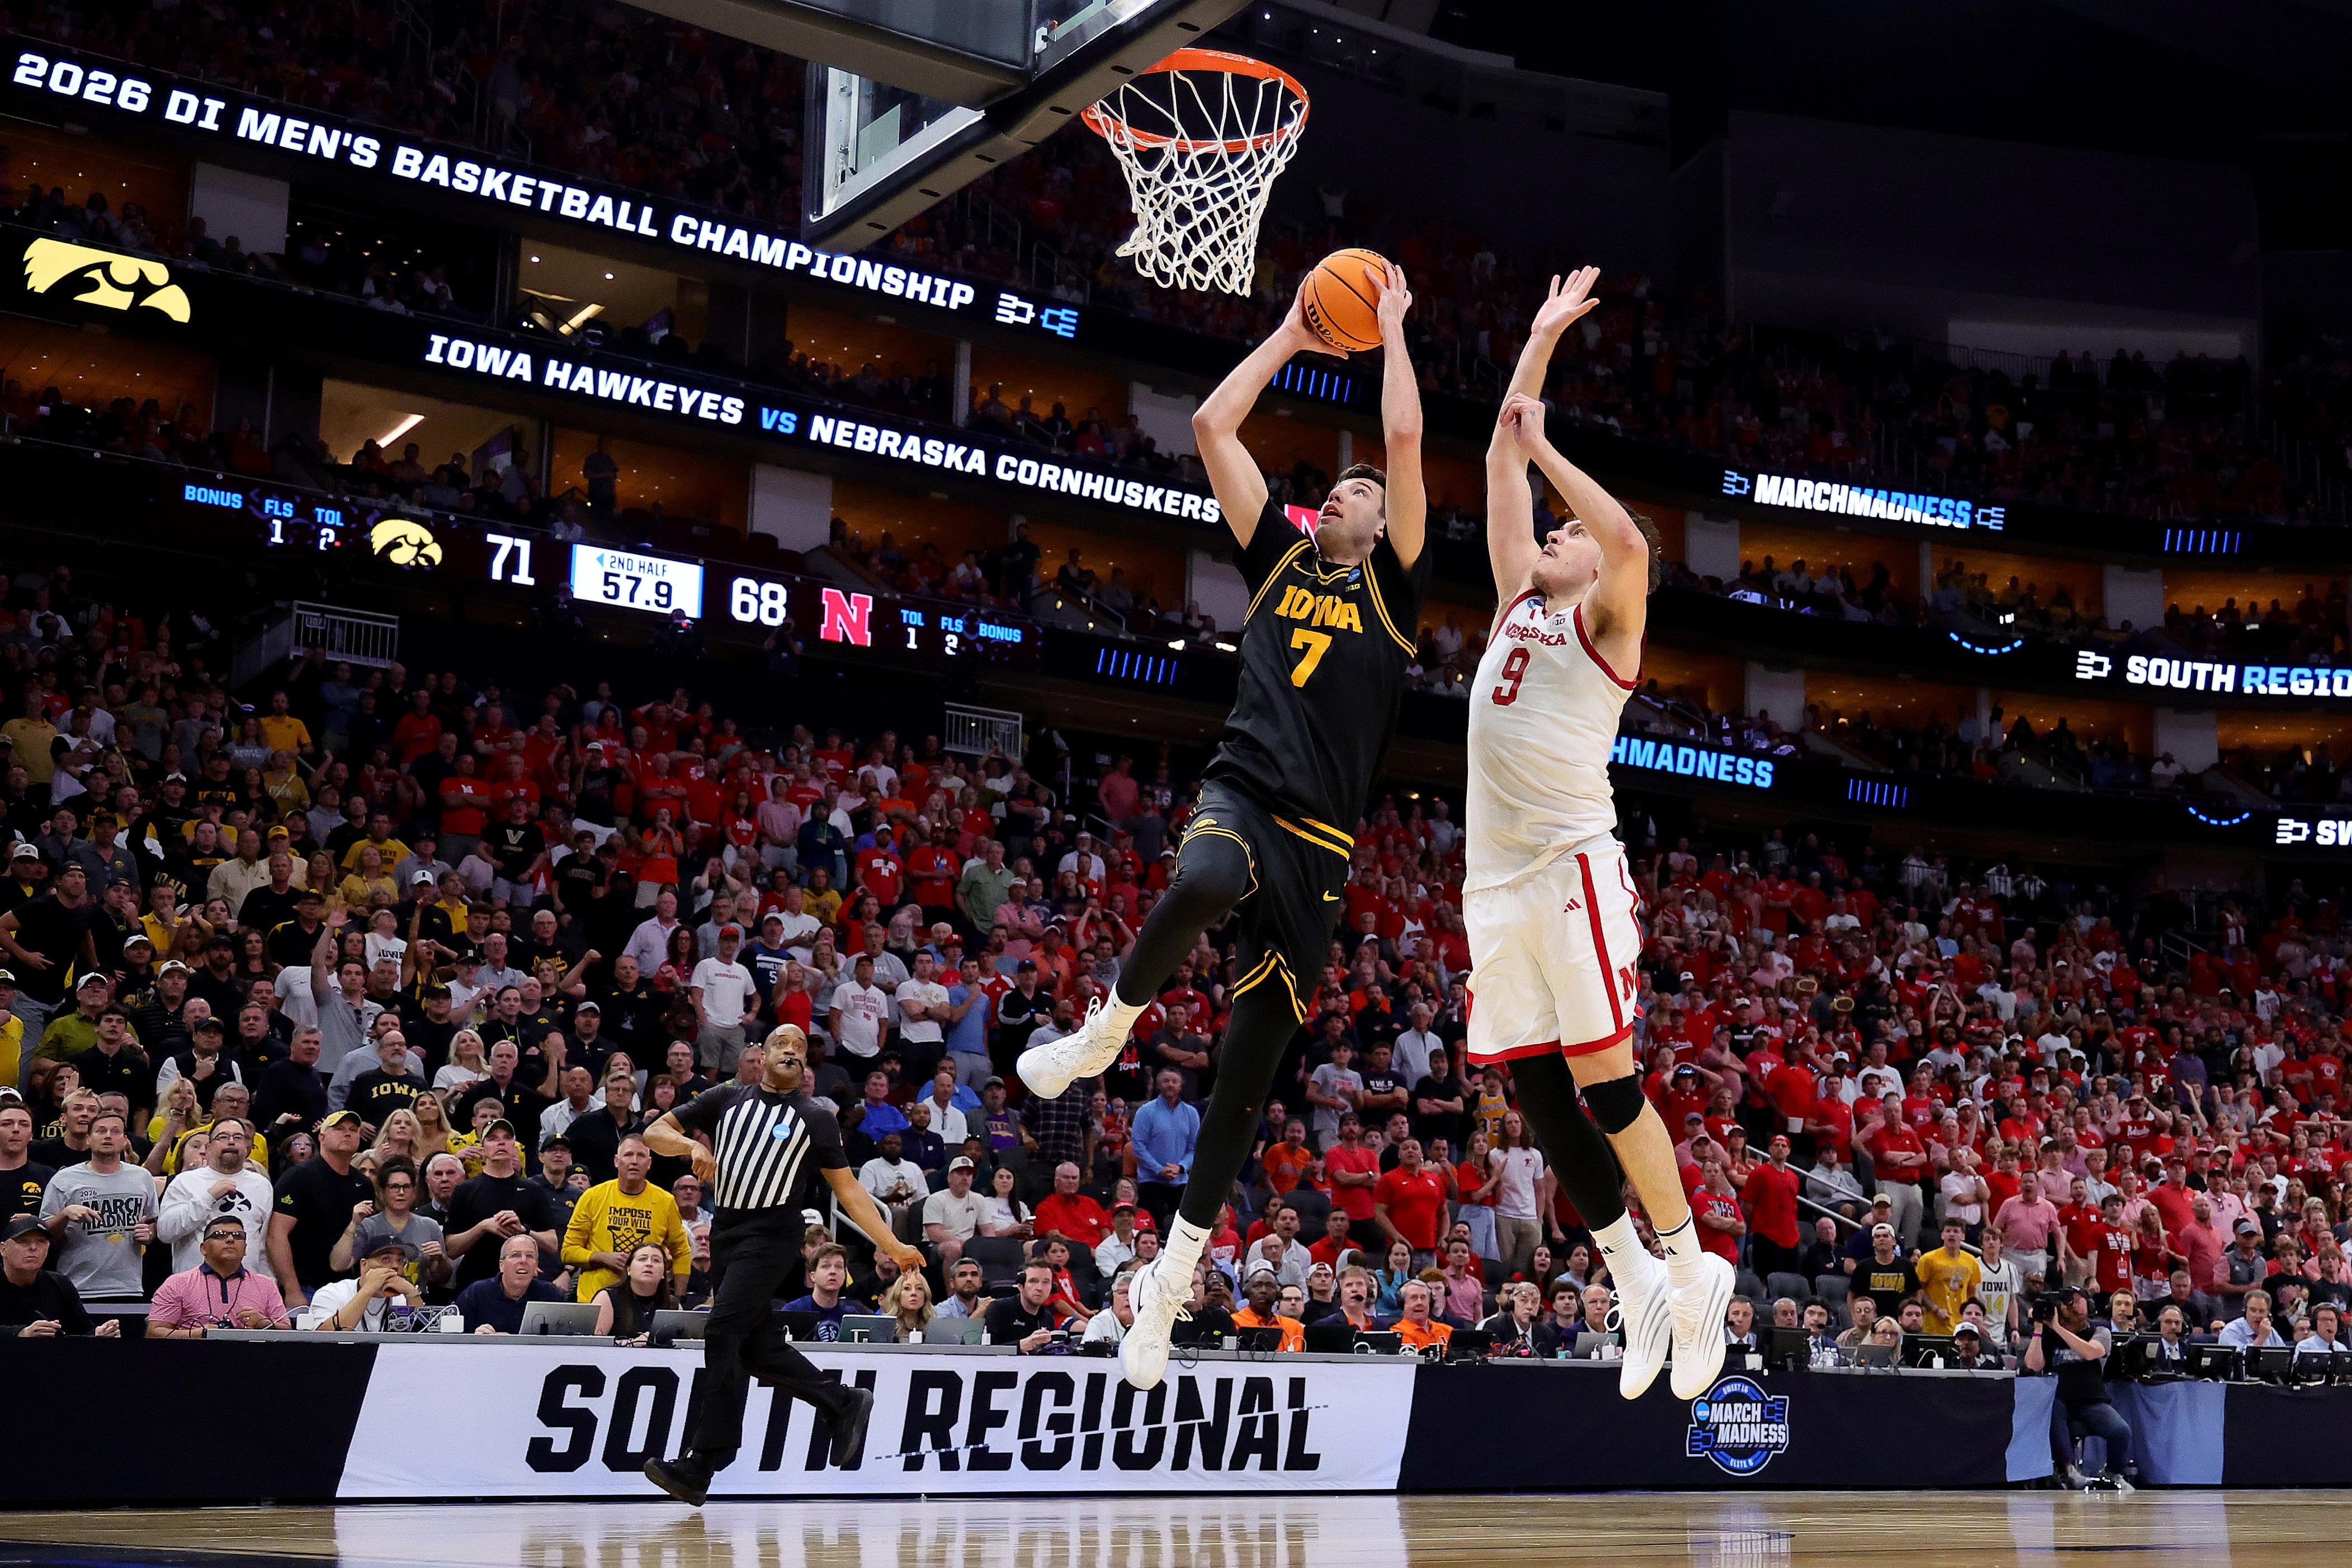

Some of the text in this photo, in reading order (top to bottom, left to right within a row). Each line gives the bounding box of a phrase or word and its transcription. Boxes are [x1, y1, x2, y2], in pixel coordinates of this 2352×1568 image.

[13, 53, 975, 309] 2026 DI MEN'S BASKETBALL CHAMPIONSHIP
[425, 334, 1221, 523] IOWA HAWKEYES VS NEBRASKA CORNHUSKERS
[184, 484, 345, 527] BONUS FLS TOL
[271, 519, 284, 544] 1
[487, 533, 535, 585] 71
[610, 555, 667, 577] 2ND HALF
[603, 571, 673, 608] 57.9
[731, 577, 787, 626] 68
[820, 587, 873, 647] N
[900, 609, 1022, 643] TOL FLS BONUS
[1274, 585, 1363, 634] IOWA
[906, 627, 918, 649] 1
[1290, 628, 1333, 688] 7
[2126, 655, 2236, 692] SOUTH
[1491, 648, 1531, 706] 9
[371, 1082, 418, 1098] IOWA
[82, 1197, 143, 1218] MARCH
[608, 1207, 651, 1219] IMPOSE
[608, 1216, 650, 1229] YOUR WILL
[1985, 1295, 2004, 1315] 14
[901, 1370, 1321, 1472] REGIONAL
[1709, 1402, 1761, 1423] MARCH
[1717, 1423, 1786, 1443] MADNESS
